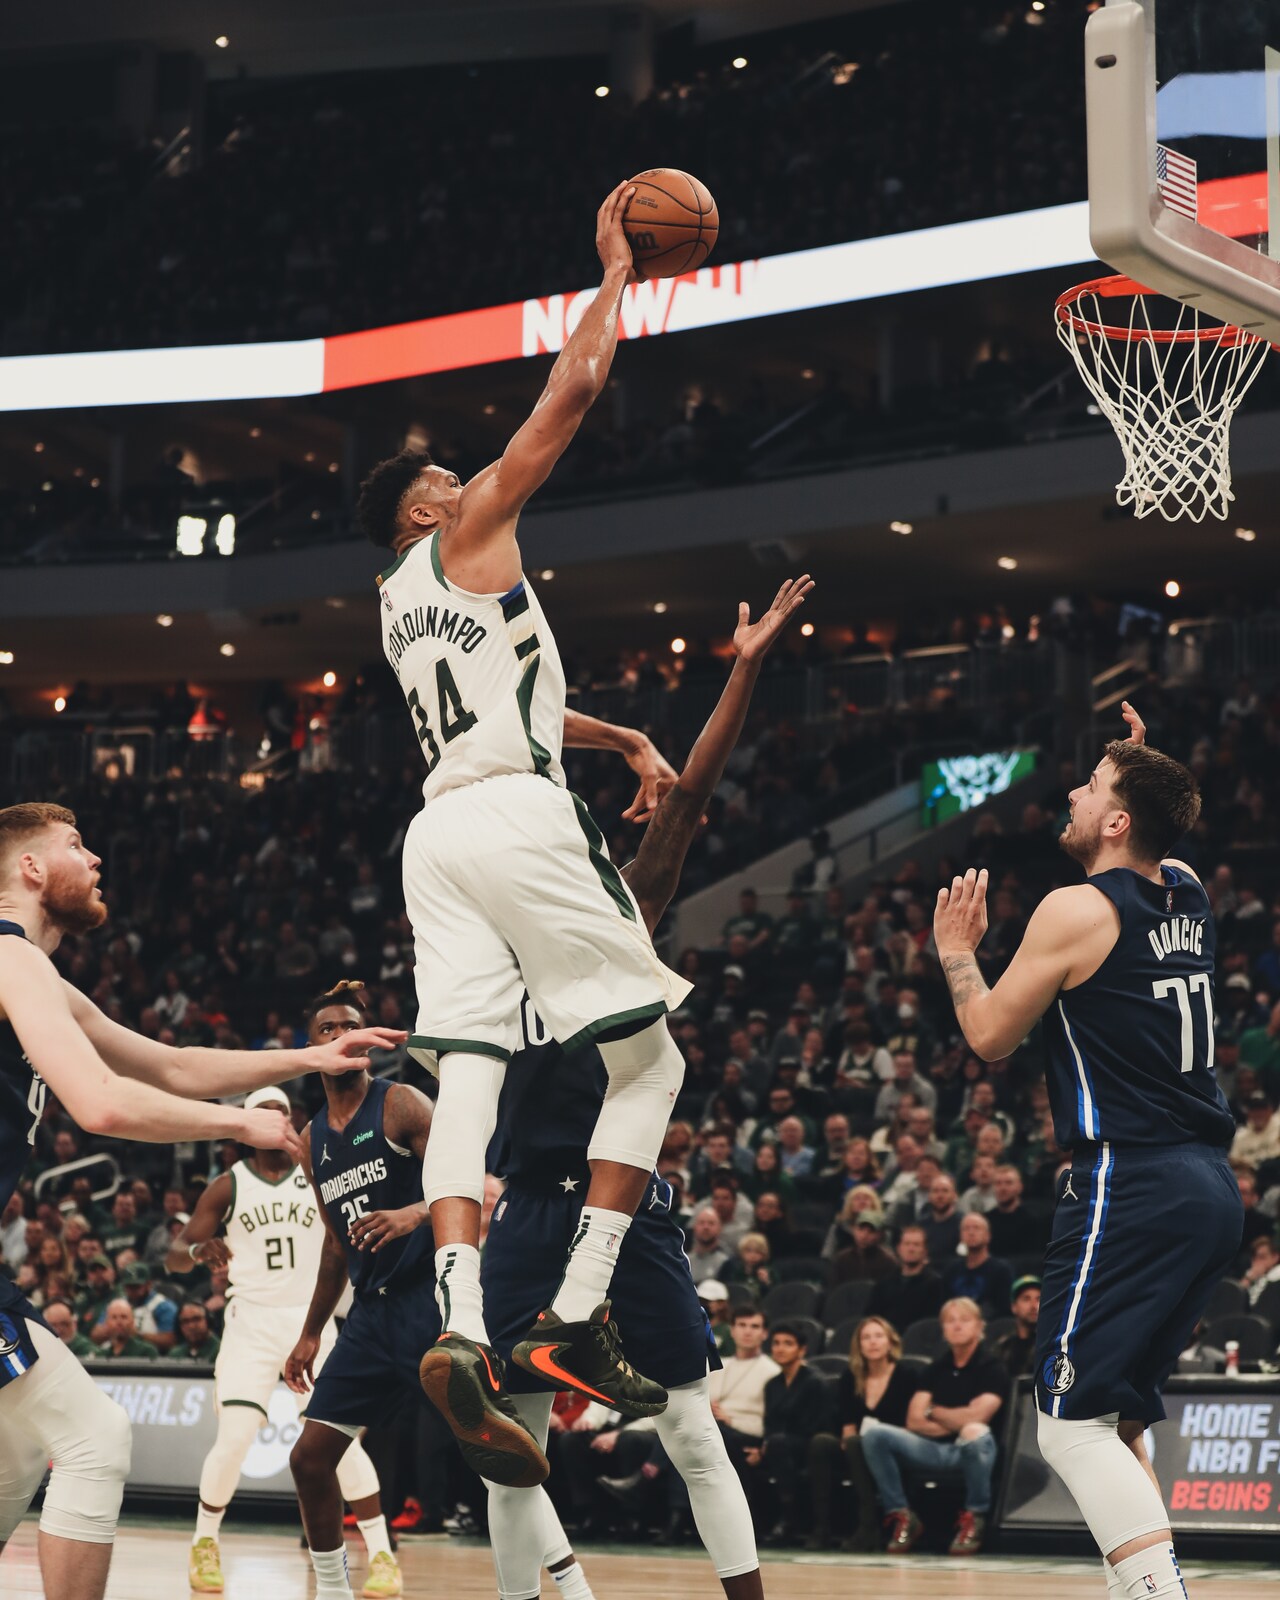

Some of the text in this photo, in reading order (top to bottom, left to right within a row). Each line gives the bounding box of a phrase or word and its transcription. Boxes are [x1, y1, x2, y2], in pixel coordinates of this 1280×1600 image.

[408, 657, 479, 771] 34
[1148, 914, 1206, 961] DONČIĆ
[1152, 973, 1214, 1073] 77
[352, 1130, 374, 1146] chime
[320, 1157, 388, 1205] MAVERICKS
[239, 1202, 317, 1233] BUCKS
[265, 1237, 295, 1271] 21
[1180, 1403, 1273, 1438] HOME
[1187, 1439, 1252, 1474] NBA
[1170, 1480, 1273, 1512] BEGINS
